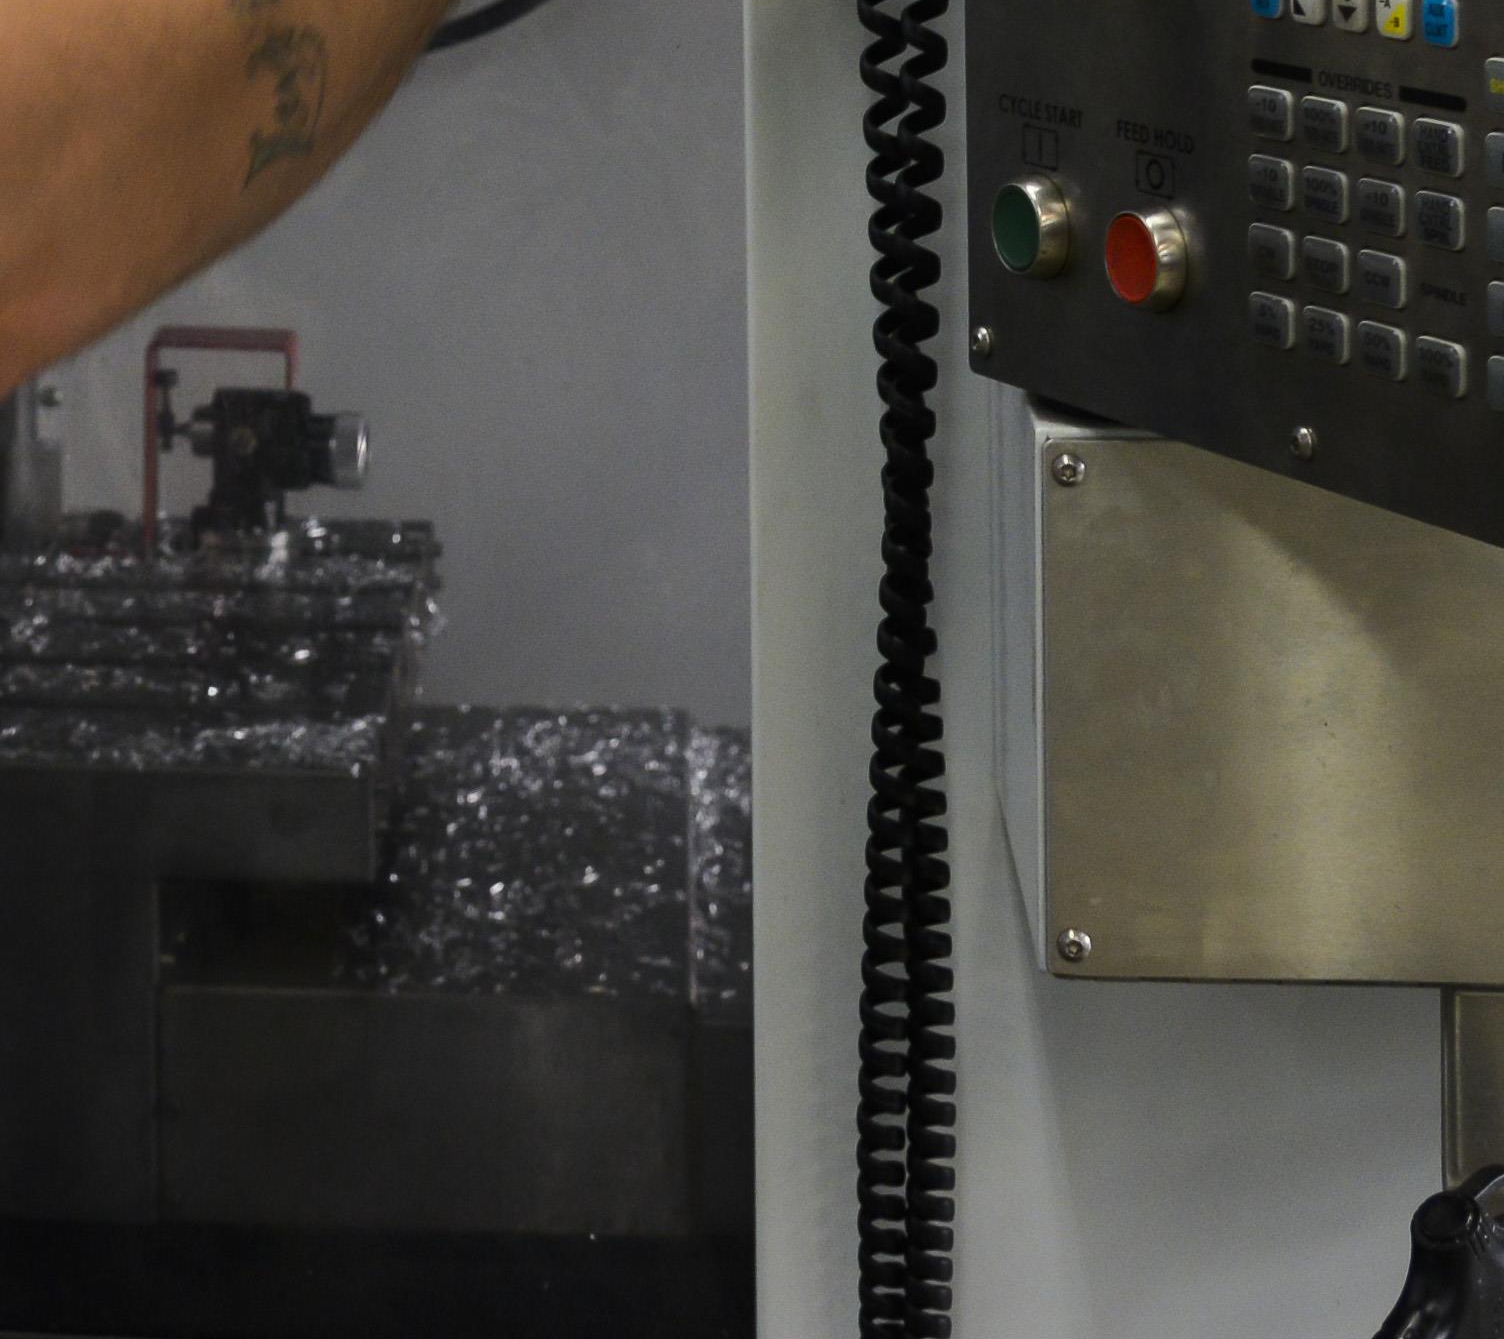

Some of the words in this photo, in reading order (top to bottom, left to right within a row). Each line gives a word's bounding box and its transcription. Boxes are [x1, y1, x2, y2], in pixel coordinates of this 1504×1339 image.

[1317, 69, 1393, 100] OVERRIDES
[997, 92, 1042, 122] CYCLE
[1045, 102, 1084, 129] START
[1115, 118, 1150, 144] FEED
[1153, 126, 1197, 155] HOLD
[1418, 281, 1468, 307] SPINDLE
